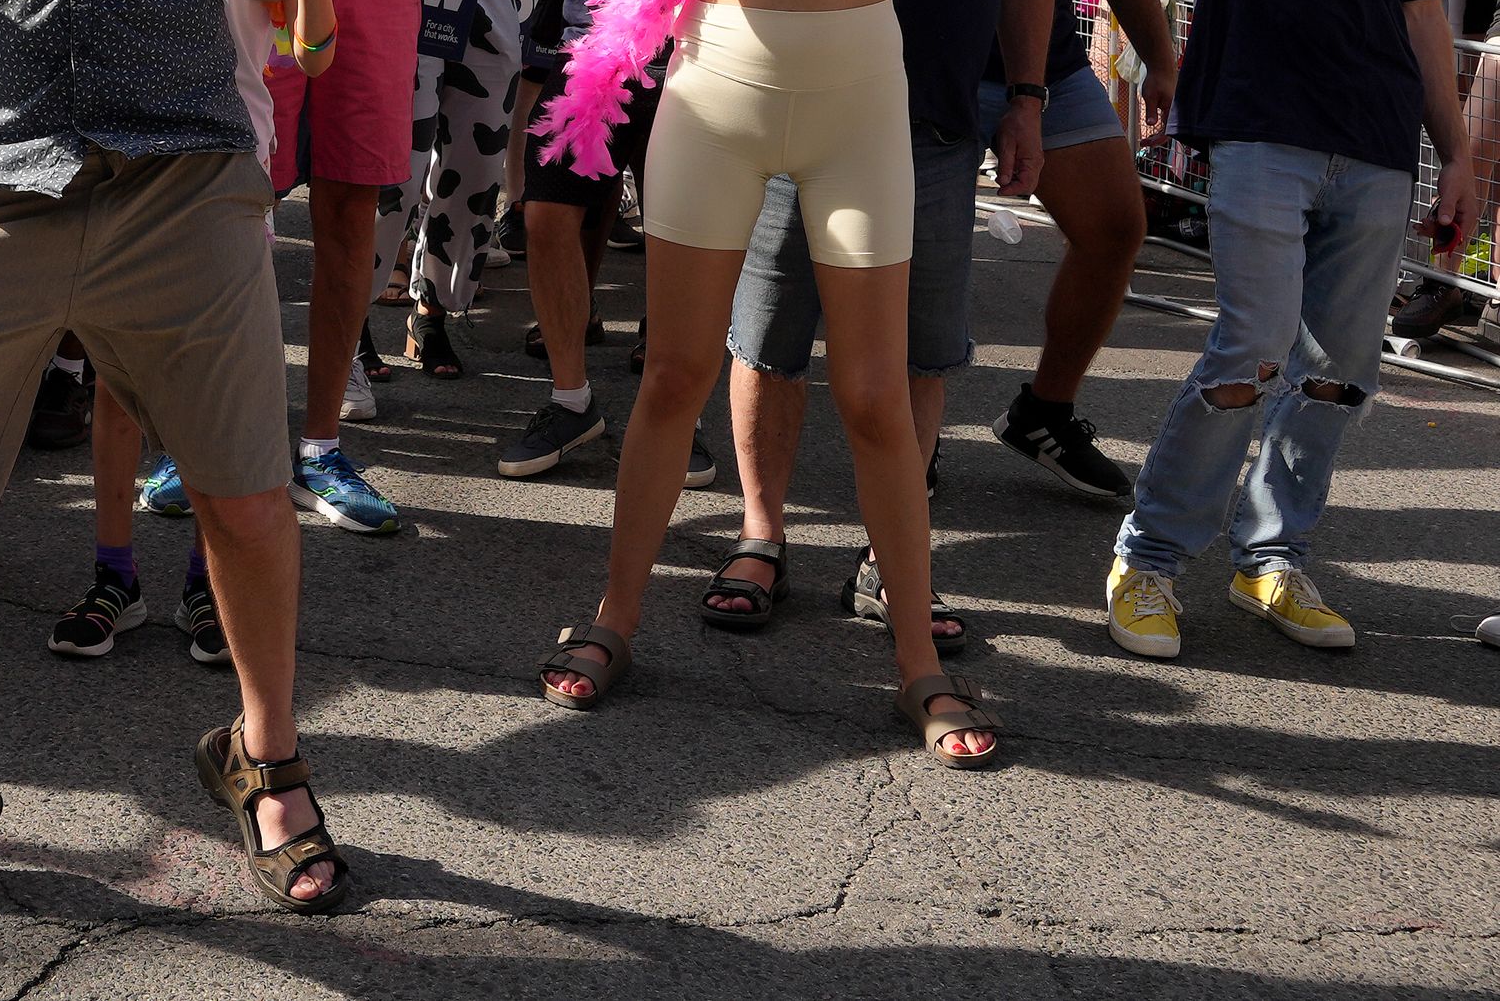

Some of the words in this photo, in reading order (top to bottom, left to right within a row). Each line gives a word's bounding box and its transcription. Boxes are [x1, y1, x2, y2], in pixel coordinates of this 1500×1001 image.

[426, 19, 438, 31] For
[438, 23, 444, 32] a
[444, 23, 456, 34] city
[424, 29, 437, 40] that
[437, 32, 458, 44] works.
